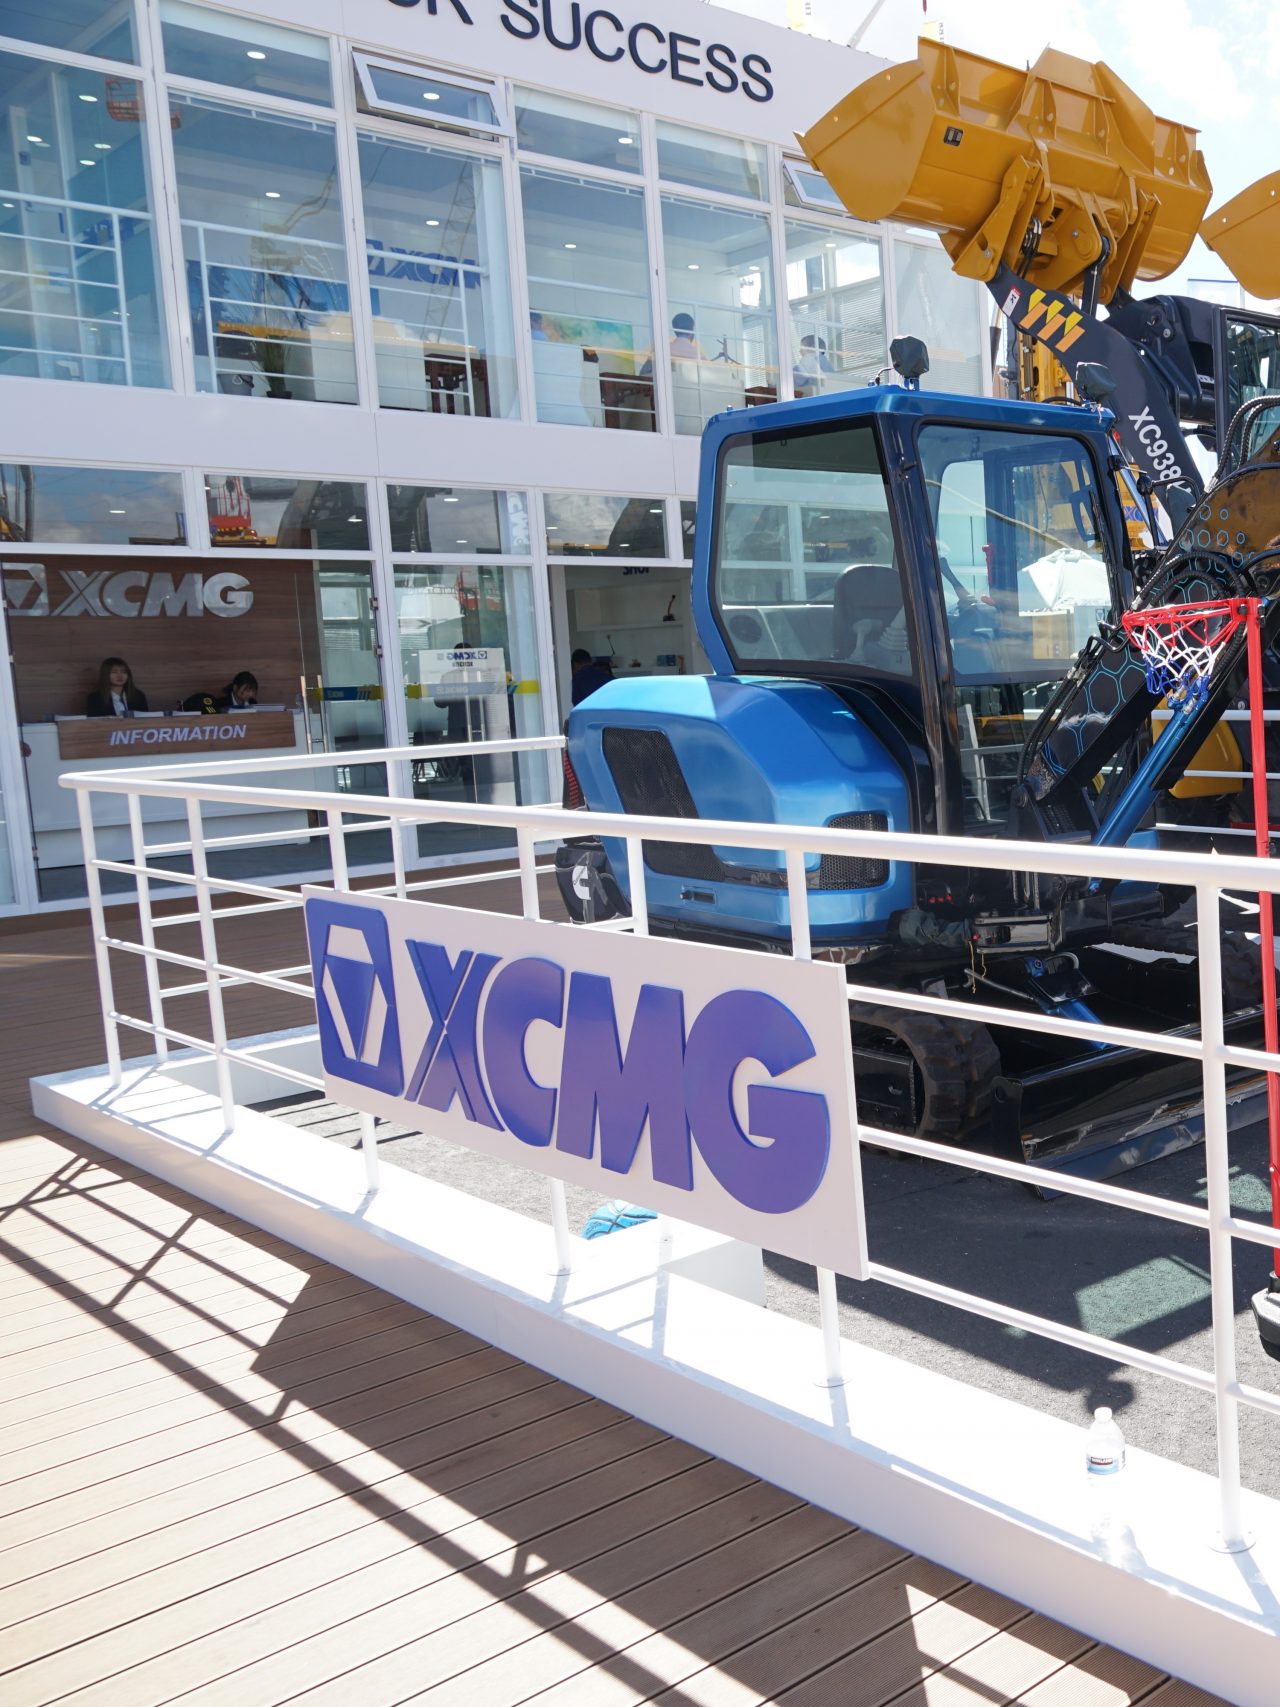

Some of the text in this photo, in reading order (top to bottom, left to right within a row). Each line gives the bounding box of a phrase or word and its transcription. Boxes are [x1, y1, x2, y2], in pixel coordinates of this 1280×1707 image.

[499, 0, 774, 103] SUCCESS
[51, 570, 254, 618] XCMG
[110, 714, 247, 746] INFORMATION
[406, 939, 830, 1214] XCMG
